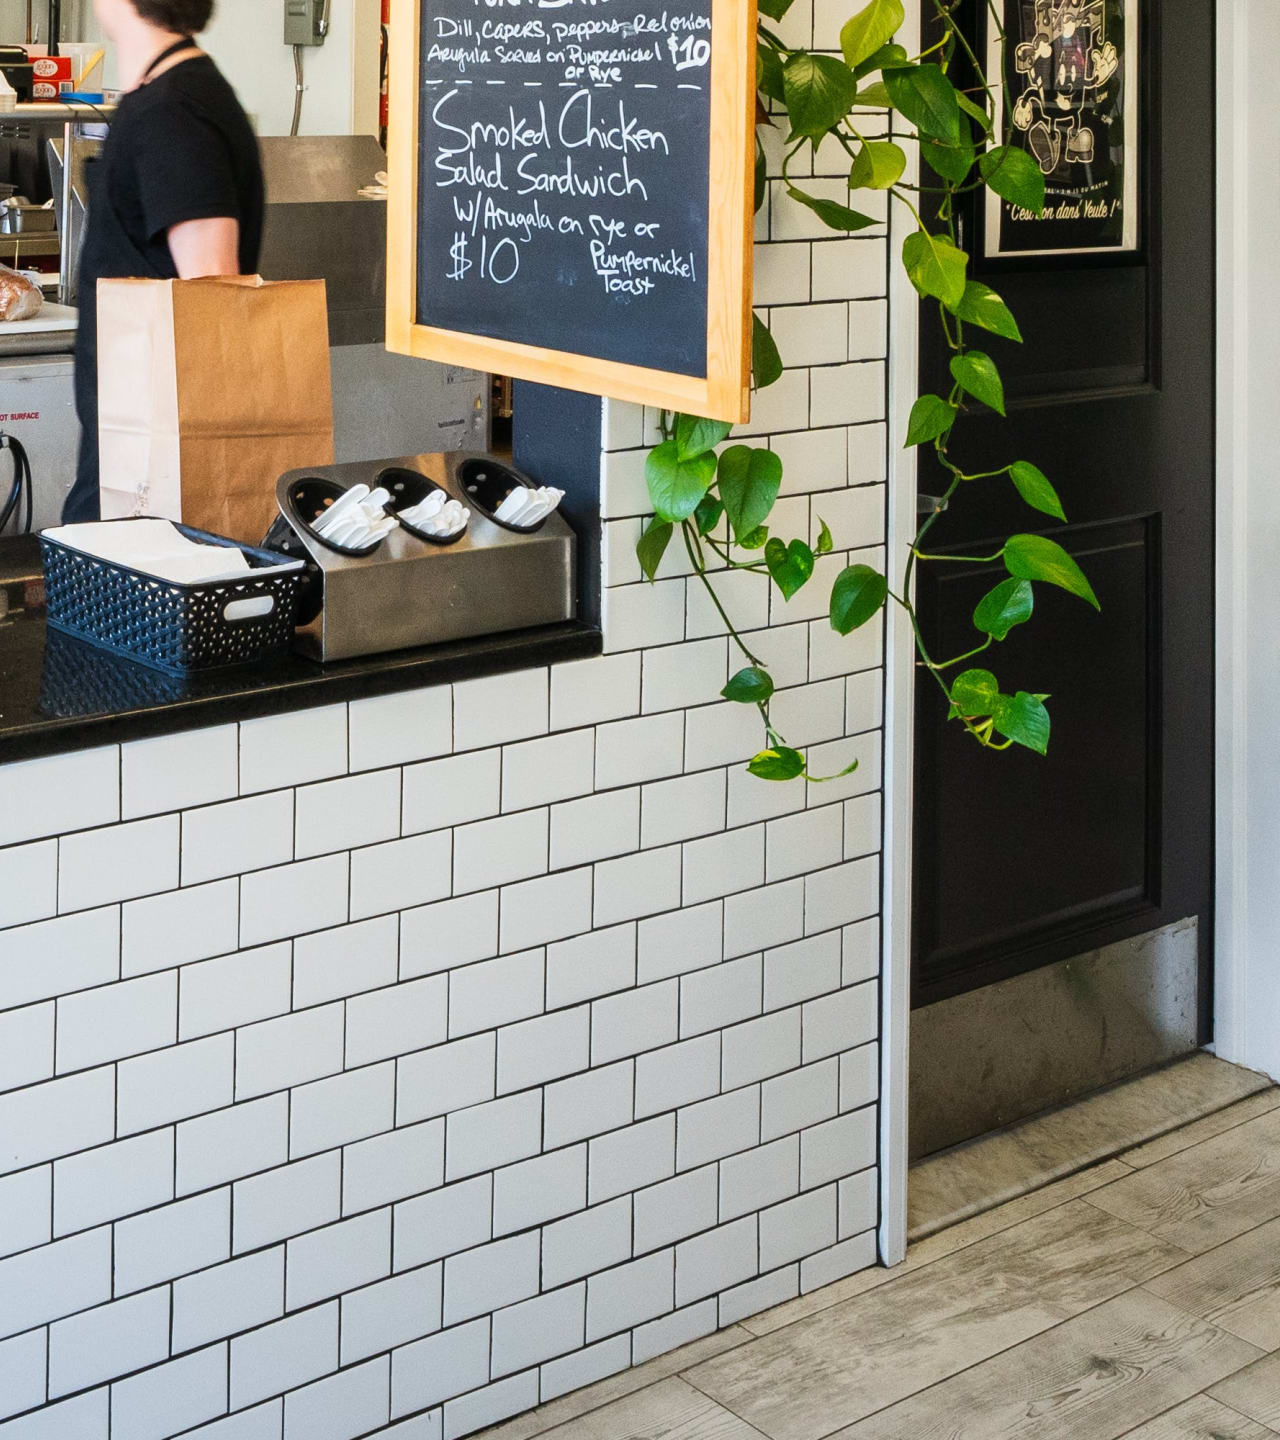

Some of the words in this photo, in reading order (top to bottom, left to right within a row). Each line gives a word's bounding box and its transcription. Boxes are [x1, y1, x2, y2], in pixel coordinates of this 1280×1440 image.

[633, 11, 667, 33] Red
[670, 13, 711, 32] onion
[667, 32, 710, 71] $10
[432, 89, 551, 154] Smoked
[558, 88, 669, 156] Chicken
[434, 151, 508, 190] Salad
[516, 152, 648, 201] Sandwich
[559, 215, 584, 235] on
[634, 220, 660, 240] or
[446, 231, 520, 284] $10
[590, 240, 696, 282] Pumpernickel
[597, 270, 655, 296] Toast
[10, 411, 39, 421] SURFACE
